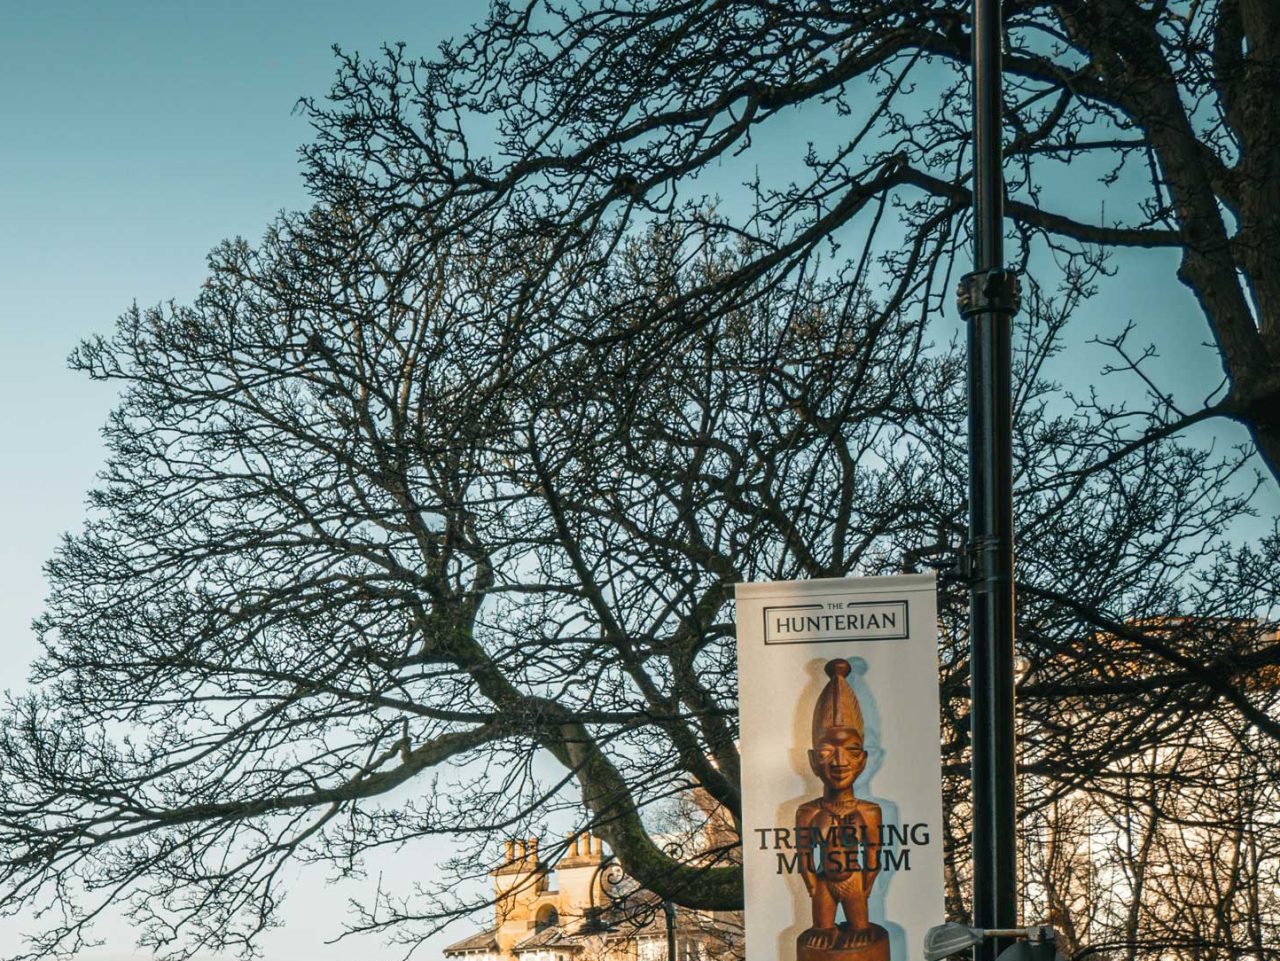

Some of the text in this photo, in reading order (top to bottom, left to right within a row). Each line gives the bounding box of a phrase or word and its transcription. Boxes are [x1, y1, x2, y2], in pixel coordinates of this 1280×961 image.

[827, 602, 844, 610] THE
[776, 612, 896, 633] HUNTERIAN
[829, 814, 857, 825] THE
[754, 823, 930, 850] TREMBLING
[776, 849, 911, 875] MUSEUM
